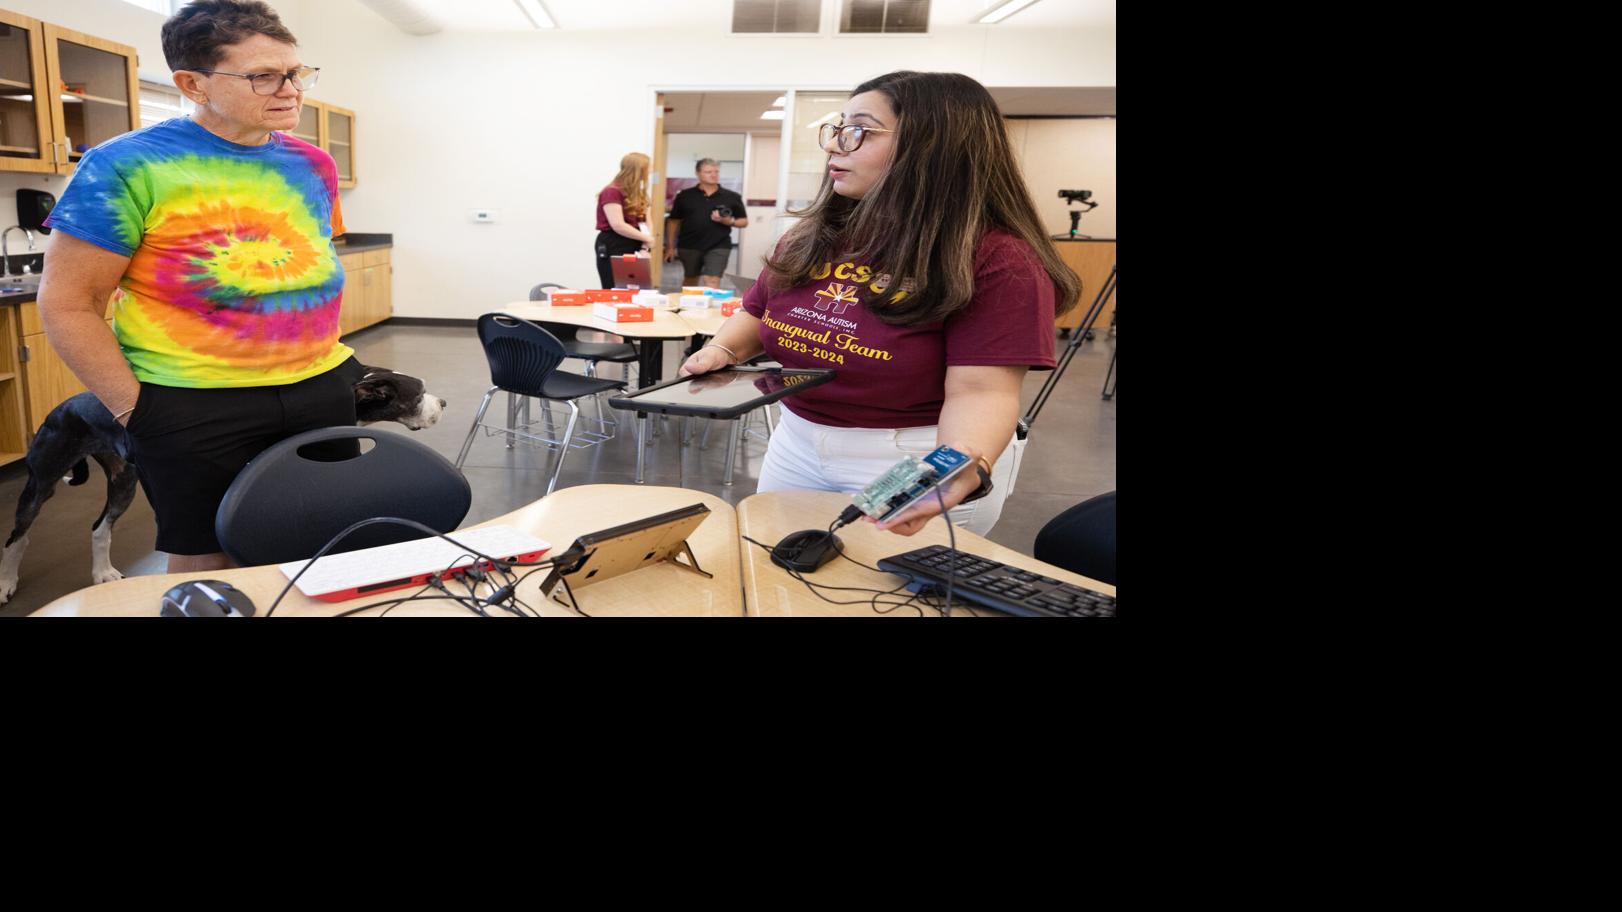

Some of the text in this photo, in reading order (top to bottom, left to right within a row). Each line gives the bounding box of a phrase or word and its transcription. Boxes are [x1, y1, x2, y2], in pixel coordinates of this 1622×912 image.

[791, 306, 858, 330] ARIZONA AUTISM
[761, 309, 893, 361] Inaugural Team
[777, 336, 845, 366] 2023-2024
